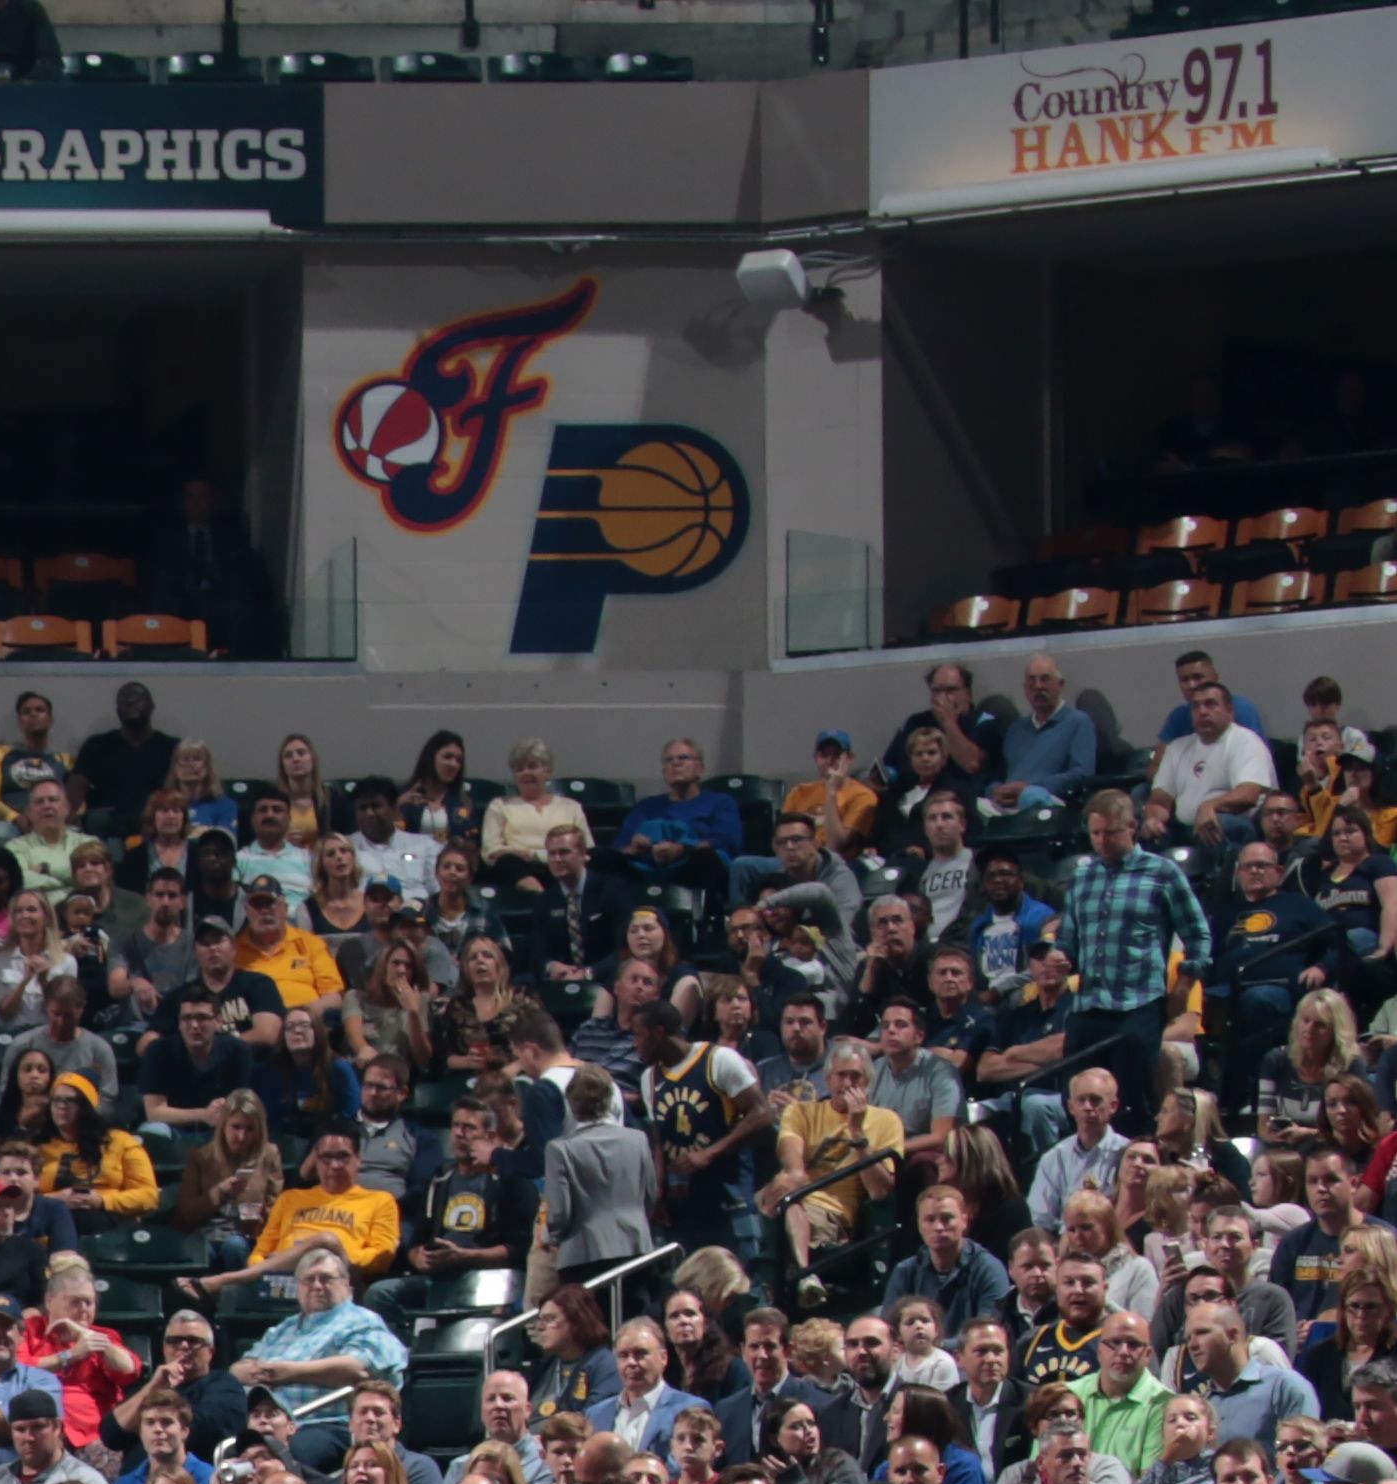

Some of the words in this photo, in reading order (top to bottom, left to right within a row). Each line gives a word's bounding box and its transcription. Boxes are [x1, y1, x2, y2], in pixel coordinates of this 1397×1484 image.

[1012, 68, 1180, 130] Country
[1182, 38, 1279, 125] 97.1
[1009, 110, 1182, 175] HANK
[1183, 118, 1279, 155] FM
[928, 869, 964, 893] CER
[1028, 1355, 1091, 1384] INDIAN
